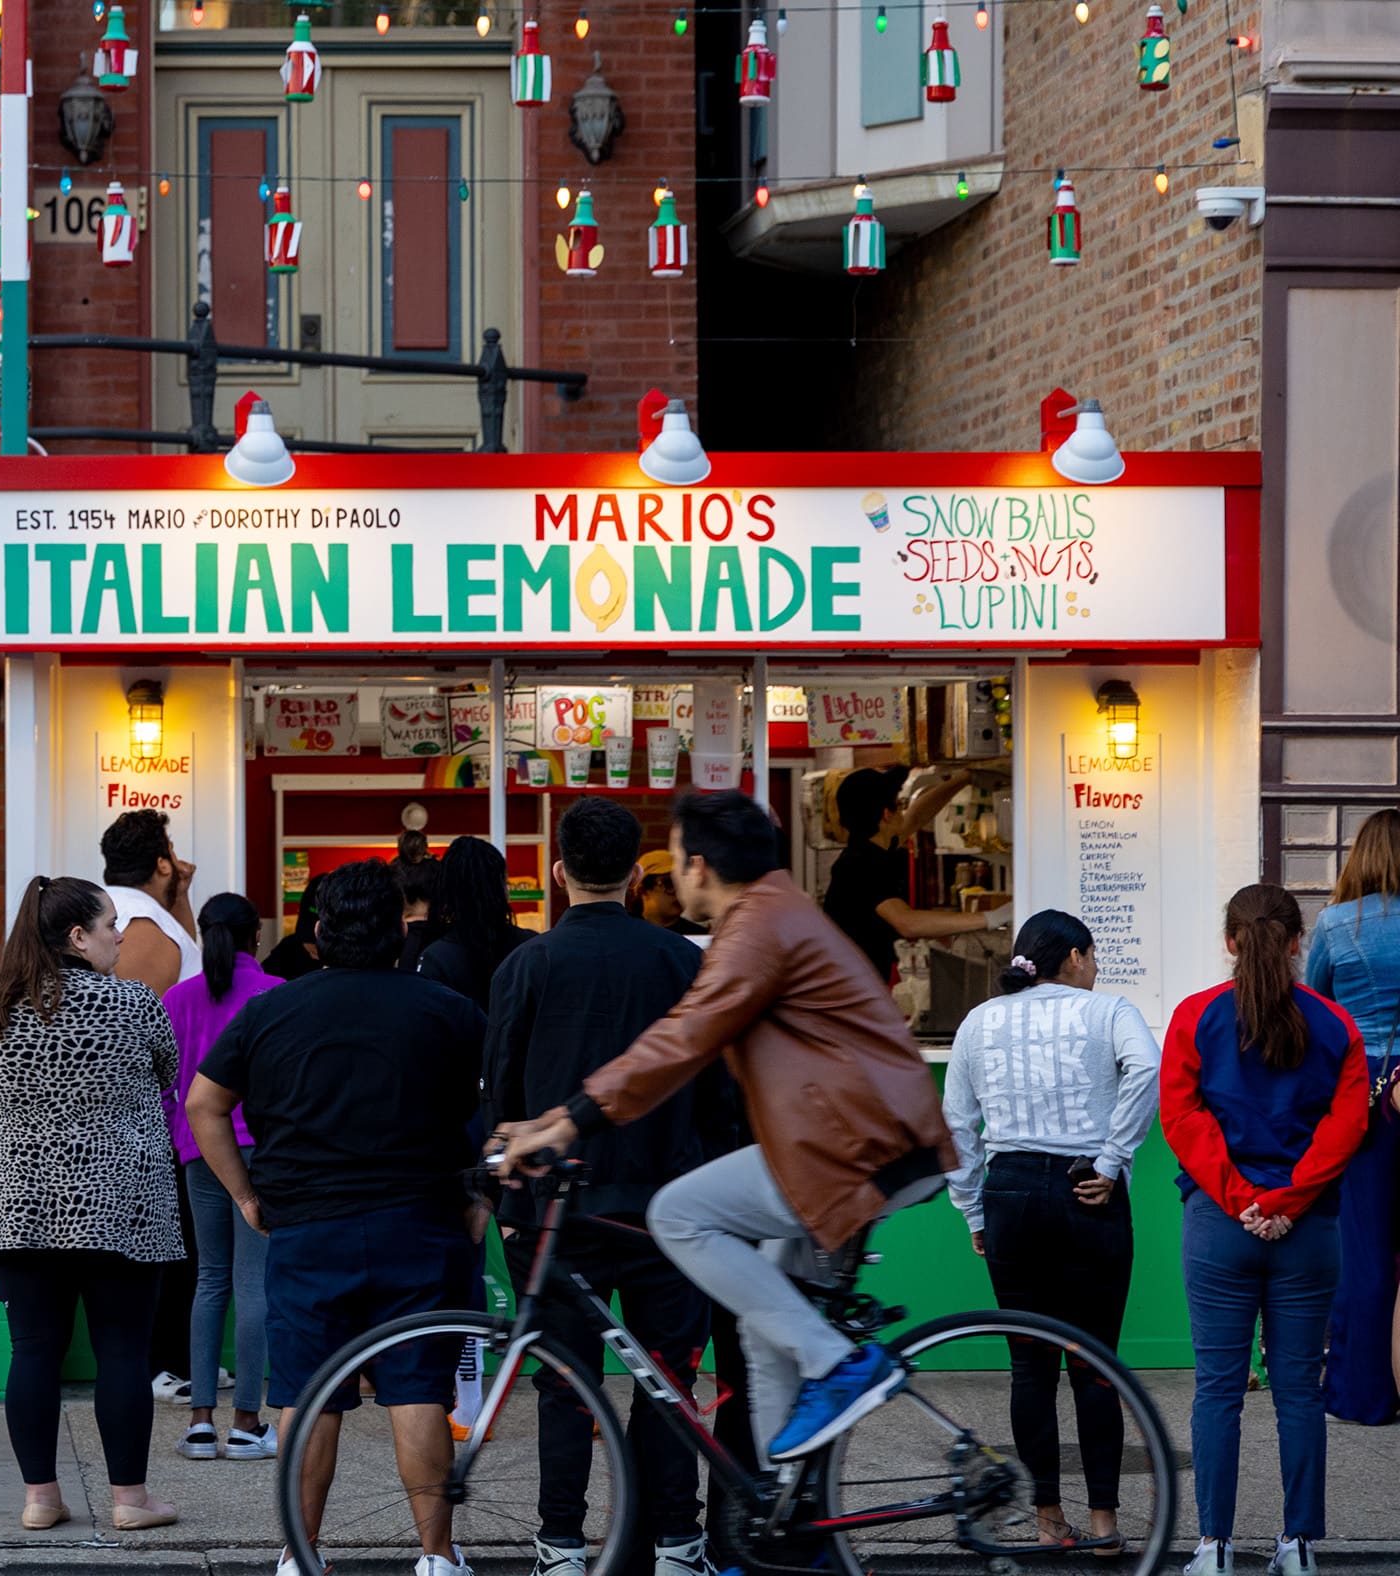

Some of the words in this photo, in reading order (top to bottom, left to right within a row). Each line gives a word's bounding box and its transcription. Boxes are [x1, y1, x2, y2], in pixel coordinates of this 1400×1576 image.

[44, 196, 127, 234] 106
[16, 509, 57, 530] EST.
[68, 509, 116, 530] 1954
[128, 508, 186, 530] MARIO
[210, 508, 301, 529] DOROTHY
[336, 508, 401, 529] PAOLO
[535, 490, 775, 542] MARIO'S
[903, 494, 999, 539] SNOW
[1005, 494, 1095, 542] BALLS
[903, 539, 999, 583] SEEDS
[1011, 540, 1094, 582] NUTS
[4, 543, 349, 635] ITALIAN
[391, 543, 861, 632] LEMONADE
[933, 584, 1057, 630] LUPINI
[554, 695, 606, 725] POG
[773, 705, 808, 716] CHO
[822, 691, 885, 724] Lychee
[101, 756, 190, 773] LEMONADE
[1069, 755, 1152, 774] LEMONADE
[108, 784, 182, 809] Flavors
[1074, 783, 1143, 809] Flavors
[1079, 820, 1115, 829] LEMON
[1080, 831, 1137, 840] WATERMELON
[1080, 842, 1123, 851] BANANA
[1080, 852, 1115, 861] CHERRY
[1080, 872, 1144, 883] STRAWBERRY
[1082, 862, 1112, 871] LIME
[1080, 894, 1120, 903] ORANGE
[1081, 904, 1135, 913] CHOCOLATE
[1082, 915, 1134, 923] PINEAPPLE
[982, 998, 1091, 1048] PINK
[984, 1040, 1092, 1092] PINK
[987, 1090, 1094, 1138] PINK
